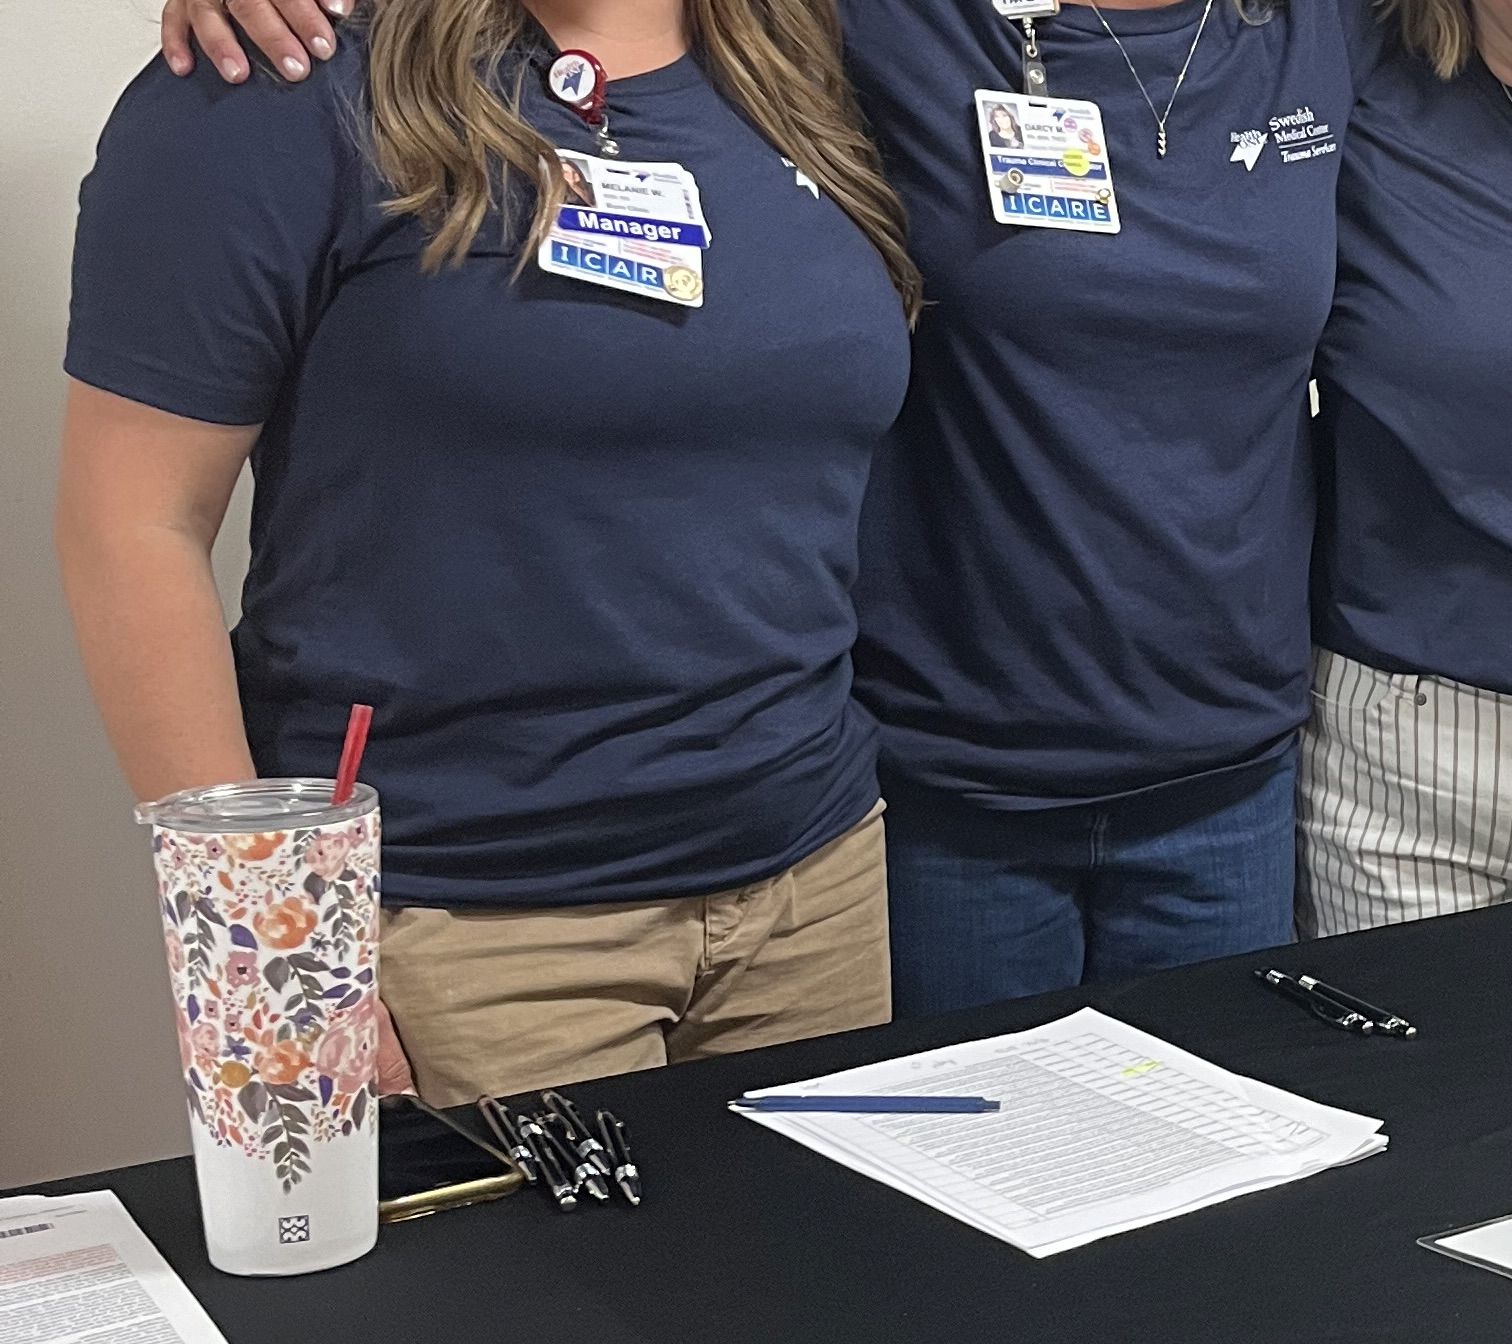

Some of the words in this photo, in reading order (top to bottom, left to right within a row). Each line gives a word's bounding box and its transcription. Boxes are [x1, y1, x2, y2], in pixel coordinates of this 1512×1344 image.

[1268, 106, 1315, 132] Swedish
[1274, 128, 1307, 144] Medical
[577, 210, 682, 242] Manager
[558, 245, 660, 285] ICAR
